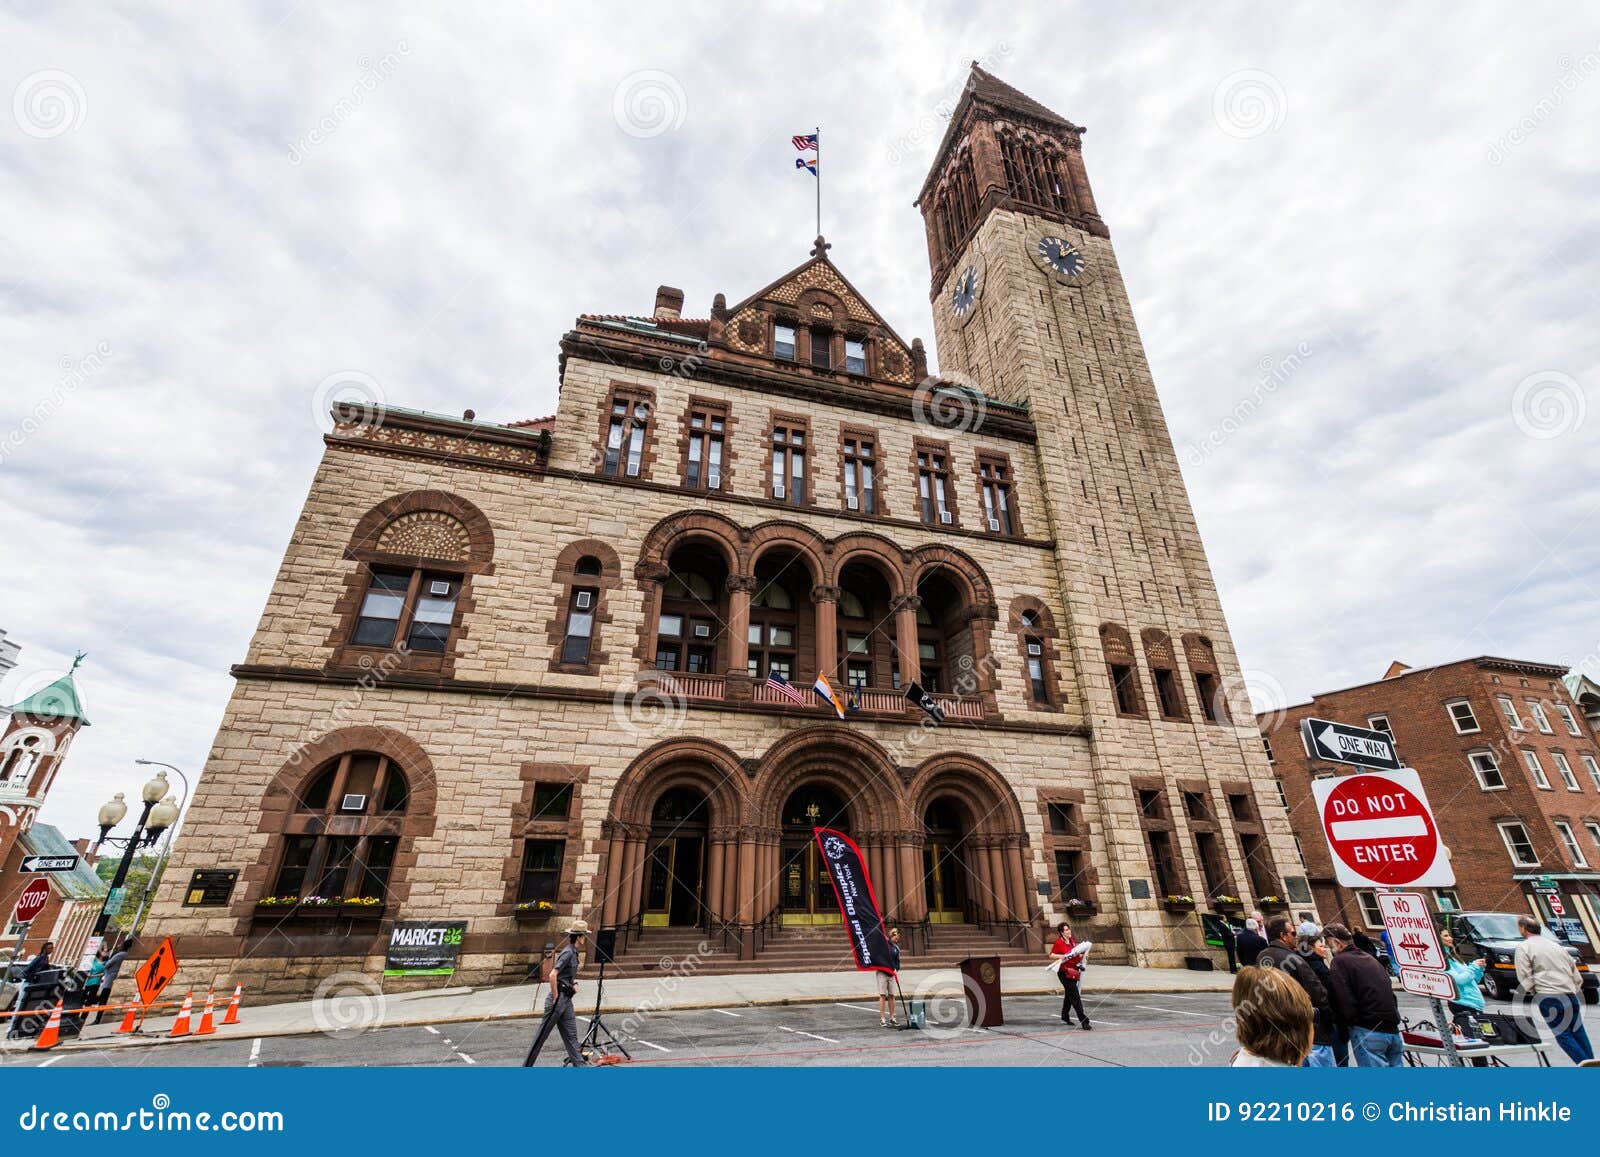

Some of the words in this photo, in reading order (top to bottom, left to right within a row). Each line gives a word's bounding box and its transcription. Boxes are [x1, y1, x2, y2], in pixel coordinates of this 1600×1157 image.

[1338, 735, 1361, 753] ONE
[1363, 738, 1386, 758] WAY
[1333, 798, 1359, 816] DO
[1366, 793, 1407, 814] NOT
[1353, 844, 1418, 863] ENTER
[37, 860, 53, 868] ONE
[834, 862, 856, 916] Olympics
[848, 880, 858, 897] New
[19, 890, 48, 909] STOP
[1393, 900, 1410, 913] NO
[1386, 915, 1430, 930] STOPPING
[390, 928, 448, 946] MARKET
[851, 919, 872, 965] Special
[1402, 932, 1421, 944] ANY
[1407, 948, 1429, 962] TIME
